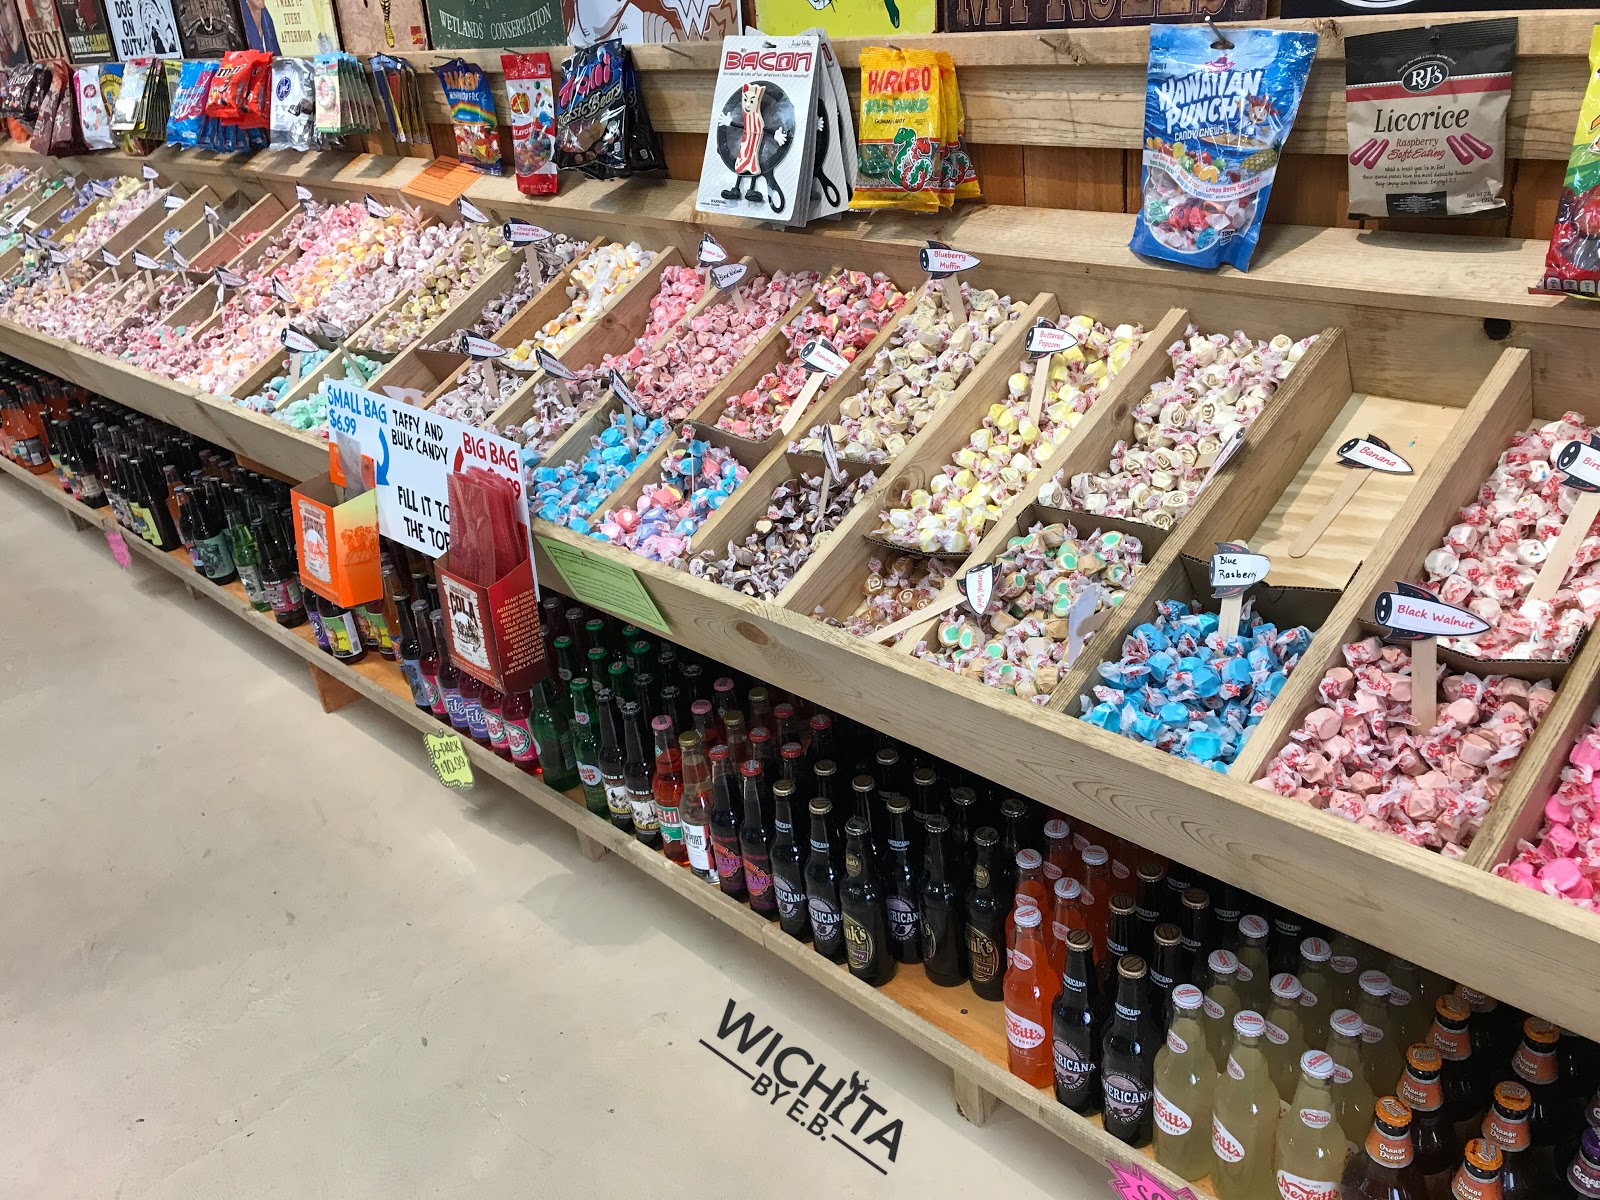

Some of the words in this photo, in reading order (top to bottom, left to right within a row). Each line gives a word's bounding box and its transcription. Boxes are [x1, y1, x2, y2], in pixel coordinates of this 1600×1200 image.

[115, 0, 133, 18] DOG
[122, 19, 135, 36] ON
[283, 12, 302, 26] EVERY
[438, 9, 484, 40] WETLANDS
[490, 3, 553, 41] CONSERVATION
[28, 30, 65, 60] SHOT
[281, 30, 313, 43] AFTERNOON
[121, 37, 143, 56] DUTY
[724, 51, 813, 72] BACON
[1410, 65, 1443, 89] RJ's
[586, 82, 622, 116] Bears
[1159, 70, 1263, 111] HAWAIIAN
[1165, 95, 1241, 135] PUNCH
[1374, 105, 1470, 133] Licorice
[1175, 128, 1197, 141] CANDY
[1198, 124, 1225, 138] CHEWS
[1396, 138, 1439, 150] Raspberry
[1387, 149, 1413, 161] Soft
[1415, 147, 1446, 160] Eating
[934, 250, 966, 262] Blueberry
[939, 261, 961, 270] Muffin
[1037, 340, 1060, 349] Popcorn
[1039, 330, 1065, 340] Buttered
[814, 351, 835, 366] Banana
[327, 385, 362, 415] SMALL
[363, 396, 388, 425] BAG
[329, 411, 357, 435] $6.99
[392, 409, 420, 434] TAFFY
[424, 422, 443, 442] AND
[391, 429, 414, 451] BULK
[416, 438, 448, 465] CANDY
[462, 432, 487, 461] BIG
[489, 441, 519, 474] BAG
[1359, 446, 1397, 467] Banana
[398, 486, 419, 513] FILL
[421, 496, 432, 518] IT
[403, 517, 425, 543] THE
[1219, 556, 1238, 565] Blue
[449, 592, 479, 628] COLA
[1397, 604, 1428, 620] Black
[1432, 612, 1475, 629] Walnut
[433, 740, 461, 760] 6-PACK
[440, 755, 466, 775] $10.99
[658, 809, 679, 823] EHI
[846, 925, 867, 944] nk's
[970, 938, 993, 957] nk's
[1433, 1039, 1457, 1053] Dream
[1434, 1032, 1458, 1047] Orange
[1053, 1050, 1096, 1073] ERICANA
[1515, 1058, 1537, 1076] Dream
[1516, 1052, 1539, 1069] Orange
[1402, 1089, 1427, 1104] Dream
[1403, 1081, 1428, 1097] Orange
[1490, 1130, 1516, 1144] Dream
[1491, 1122, 1517, 1138] Orange
[1379, 1143, 1406, 1155] Orange
[1379, 1150, 1406, 1161] Dream
[1458, 1178, 1483, 1197] Orange
